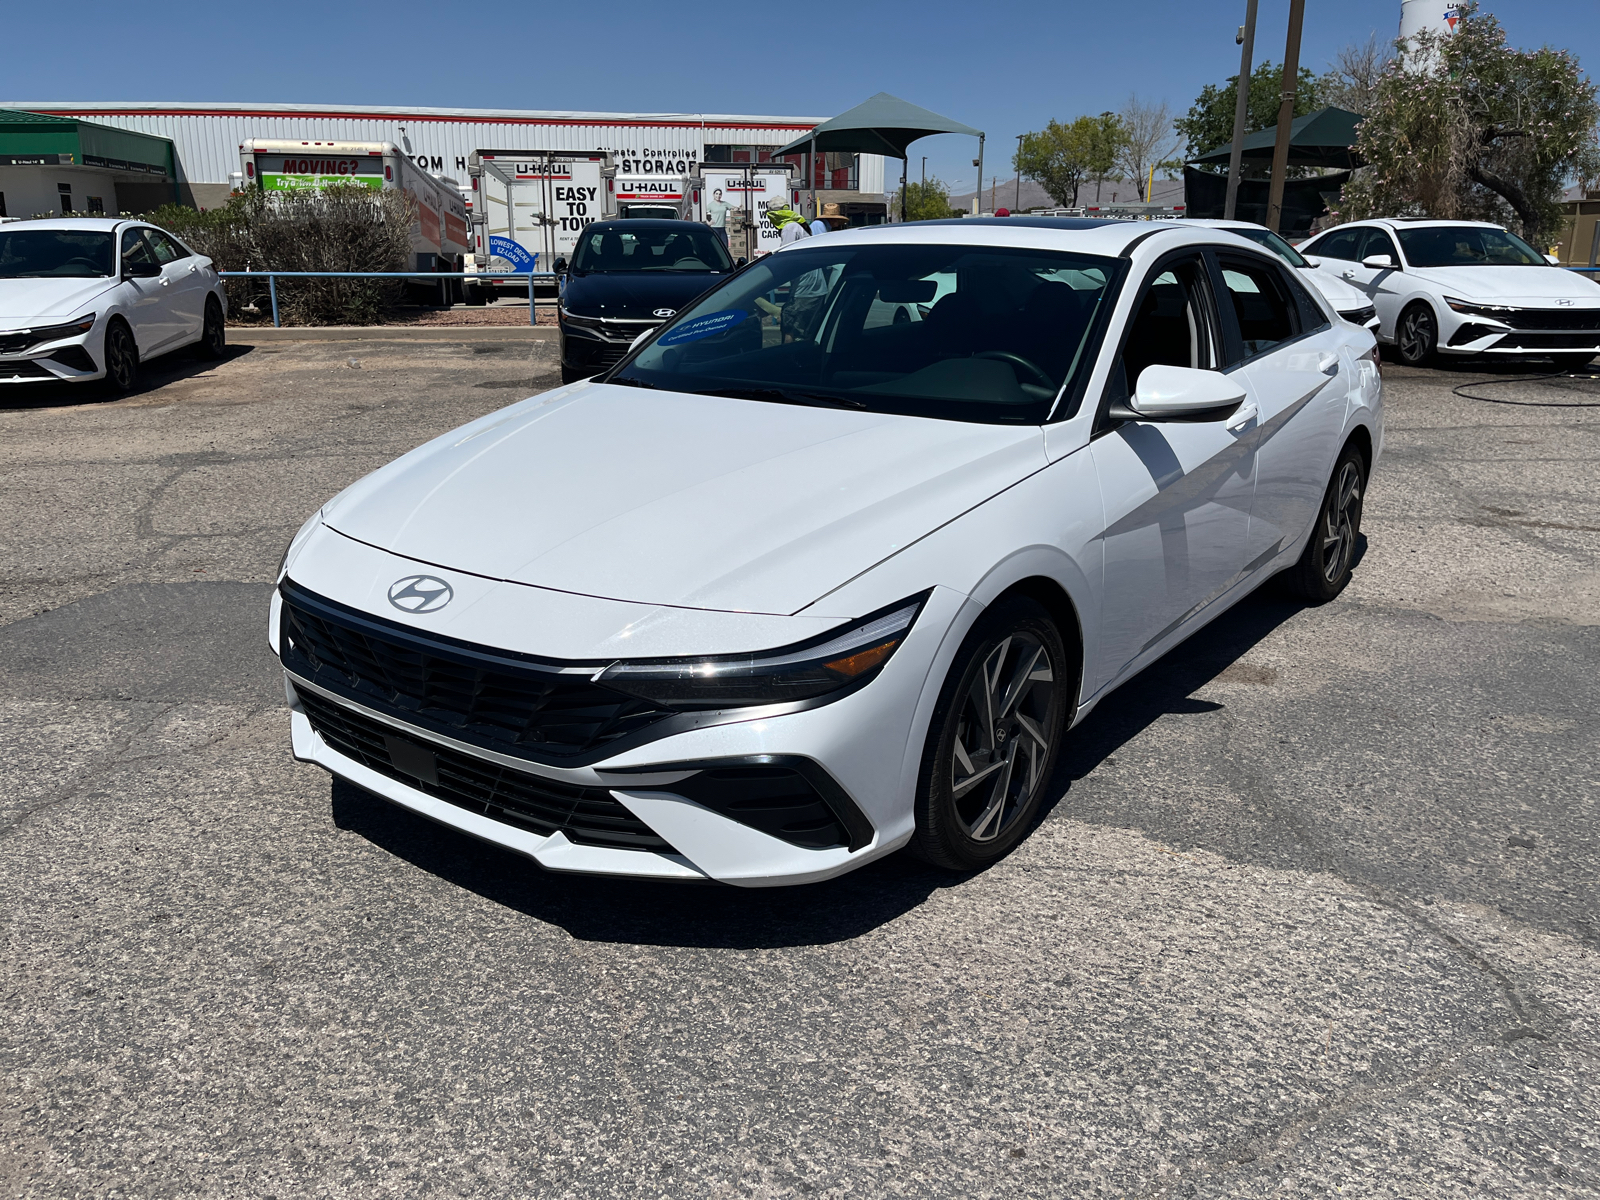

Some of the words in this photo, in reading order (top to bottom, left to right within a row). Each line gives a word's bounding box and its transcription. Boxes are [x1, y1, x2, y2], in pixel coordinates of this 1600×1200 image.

[643, 148, 697, 158] Controlled
[282, 159, 359, 176] MOVING?
[516, 163, 570, 174] U-HAUL
[276, 178, 288, 188] Try
[622, 183, 677, 192] U-HAUL
[727, 180, 765, 188] U-HAUL
[555, 187, 597, 201] EASY
[566, 202, 587, 216] TO
[490, 238, 515, 250] LOWEST
[514, 247, 531, 263] DECKS
[496, 246, 520, 263] EZ-LOAD
[691, 314, 735, 329] HYUNDAI
